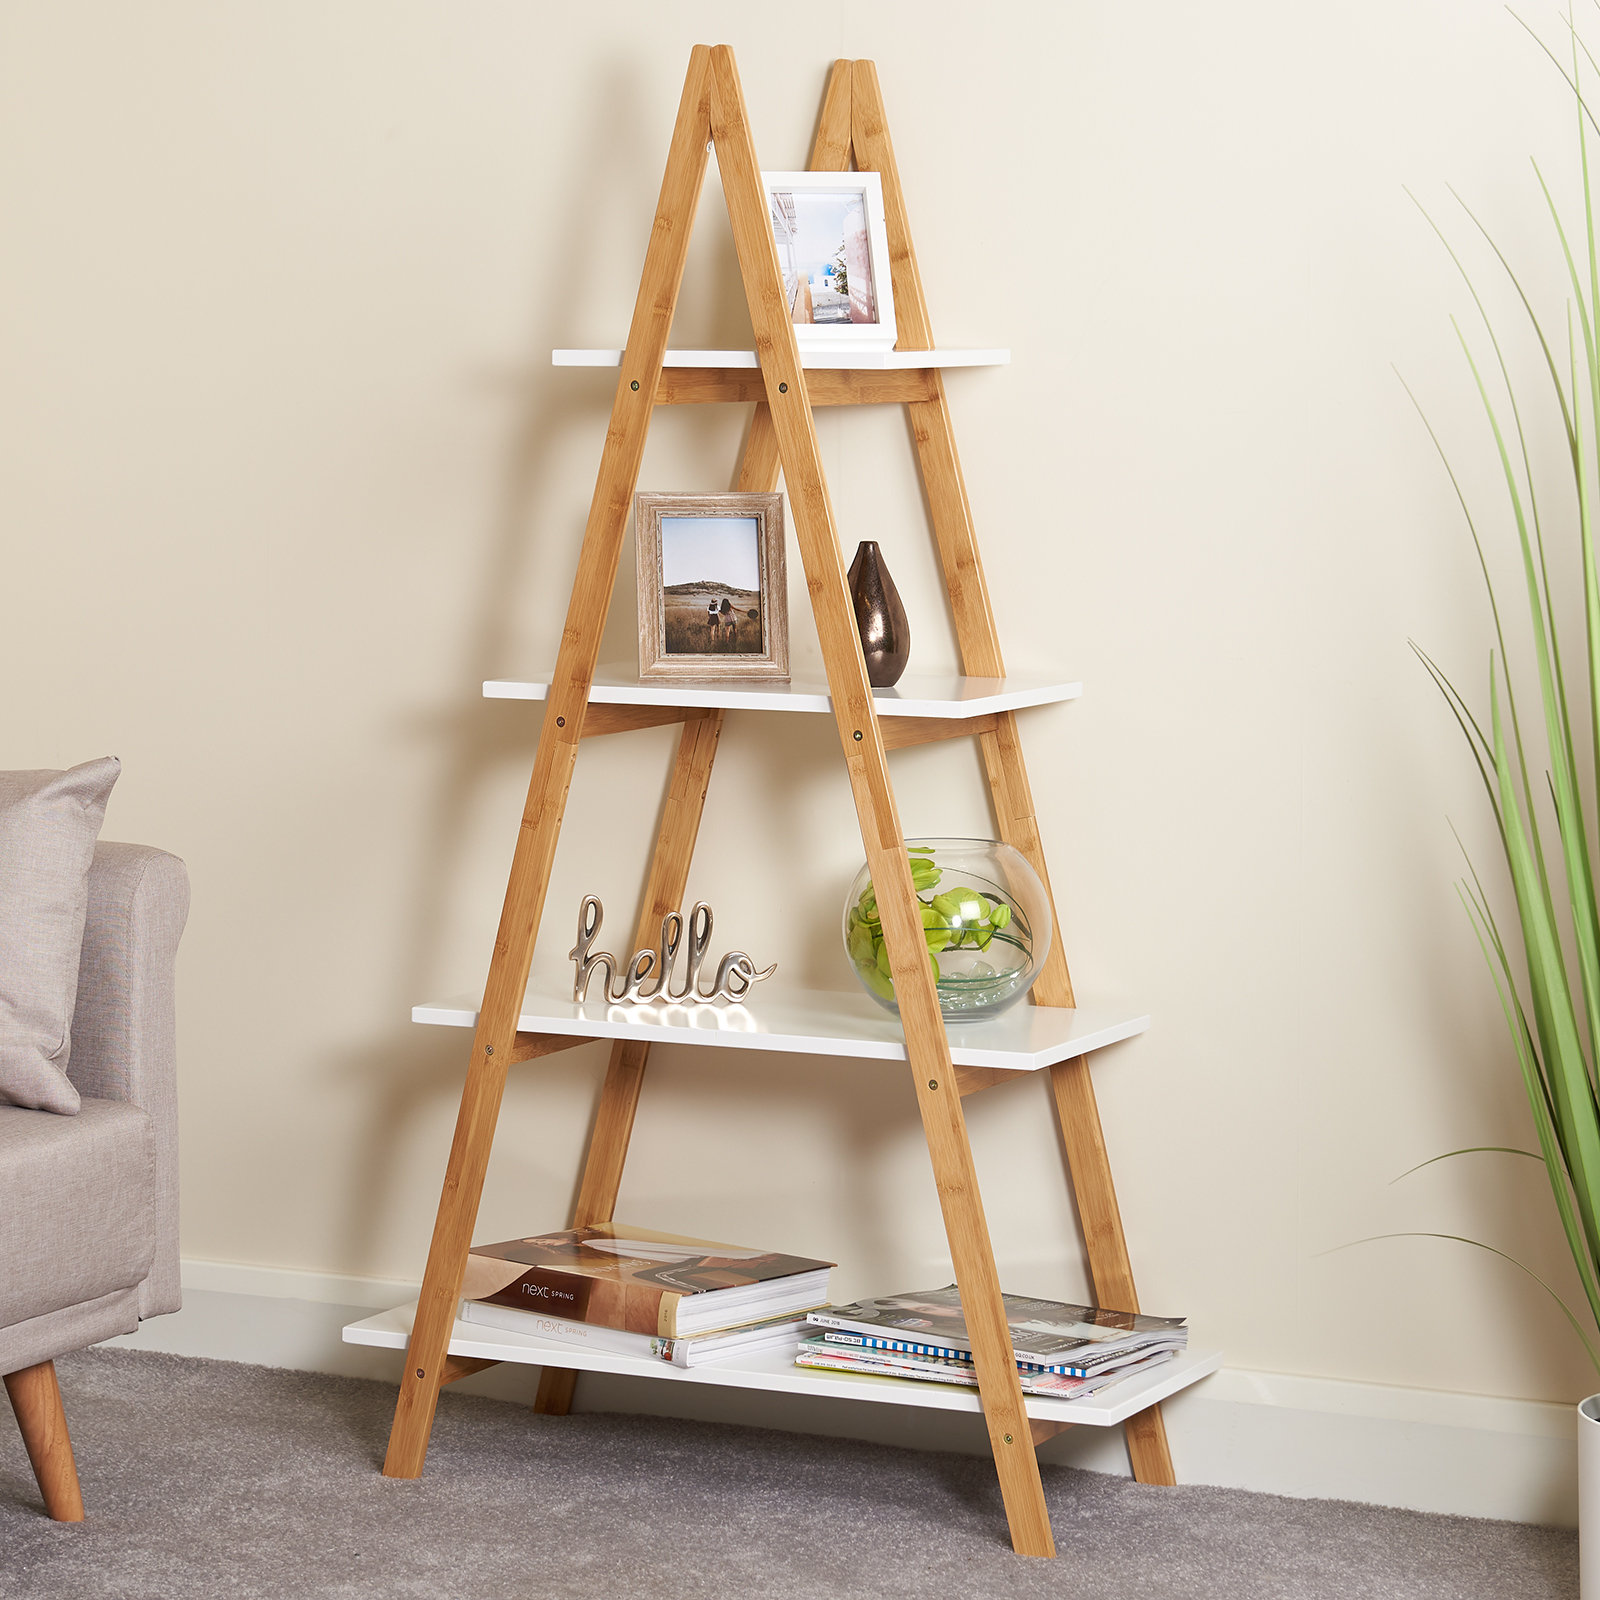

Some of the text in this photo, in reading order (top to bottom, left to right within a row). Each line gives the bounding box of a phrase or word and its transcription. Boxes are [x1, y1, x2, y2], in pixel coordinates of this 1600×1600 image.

[568, 894, 778, 1005] hello
[521, 1283, 575, 1301] next SPRING
[536, 1319, 588, 1337] next SPRING
